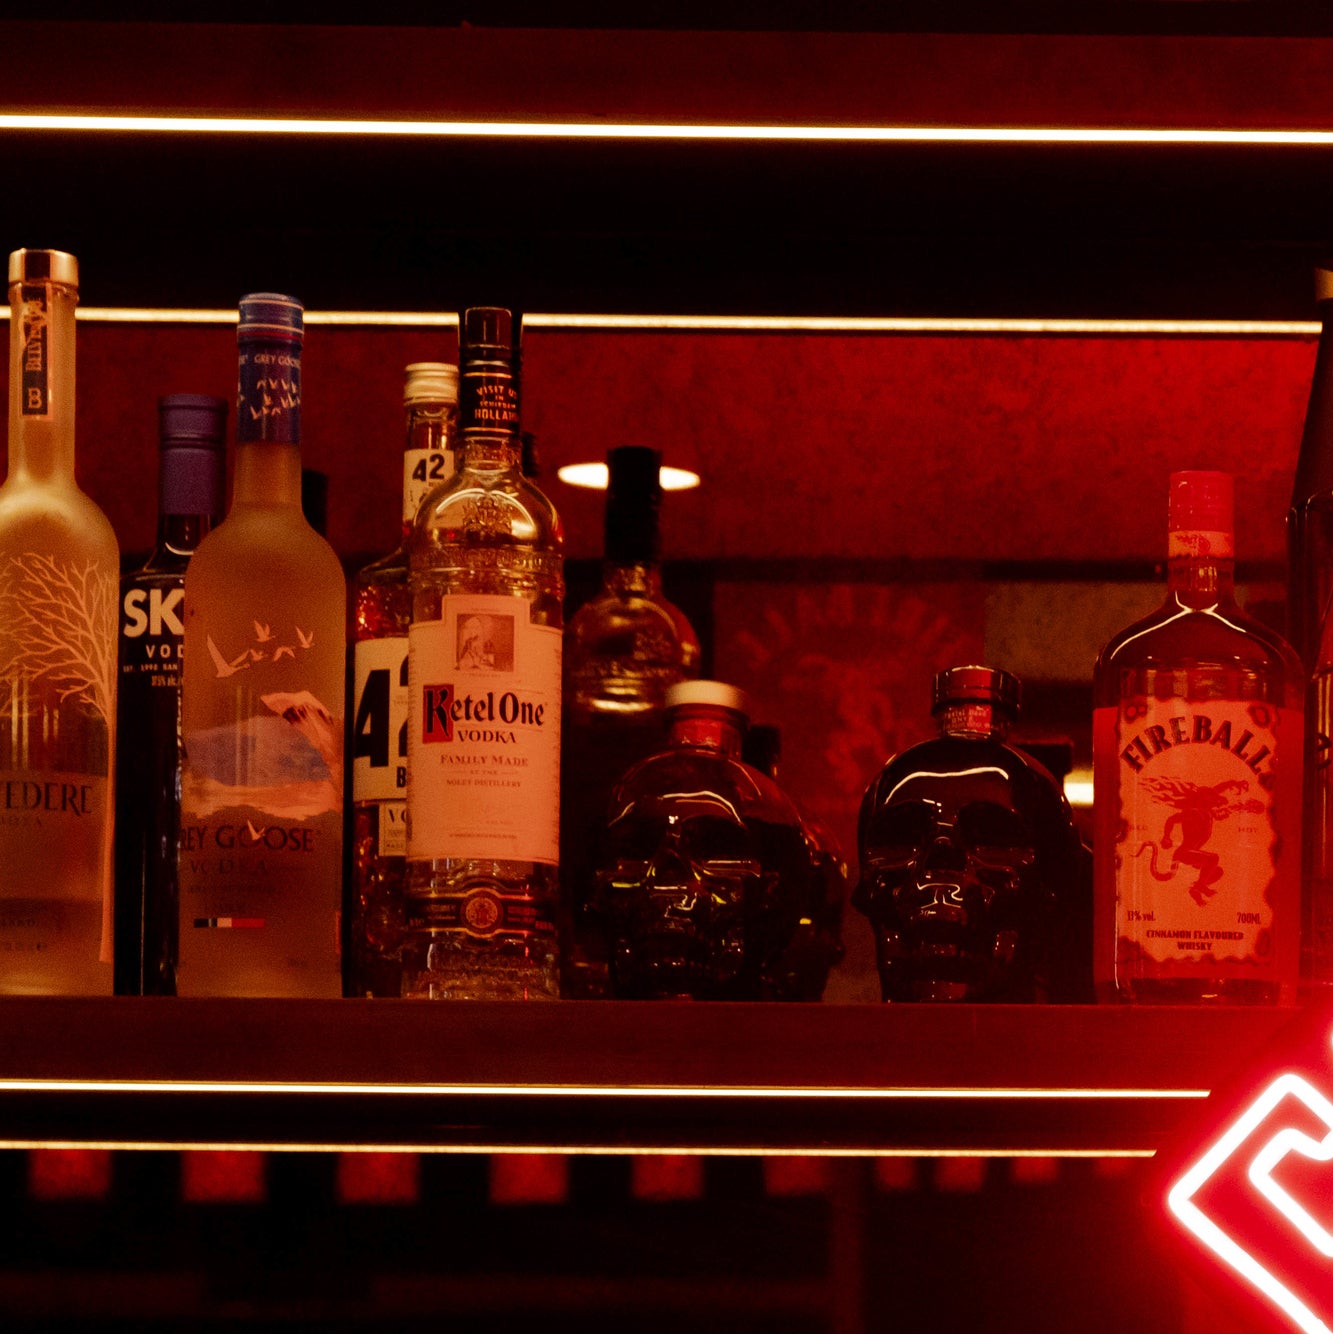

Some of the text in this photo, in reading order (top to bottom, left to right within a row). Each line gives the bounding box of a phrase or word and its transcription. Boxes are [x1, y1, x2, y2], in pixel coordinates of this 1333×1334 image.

[476, 385, 504, 396] VISIT
[426, 687, 544, 740] Ketel One
[457, 729, 517, 744] VODKA
[1119, 714, 1274, 774] FIREBALL
[440, 754, 529, 767] FAMILY MADE
[1146, 929, 1244, 941] CINNAMON FLAVOURED
[1177, 941, 1213, 952] WHISKY
